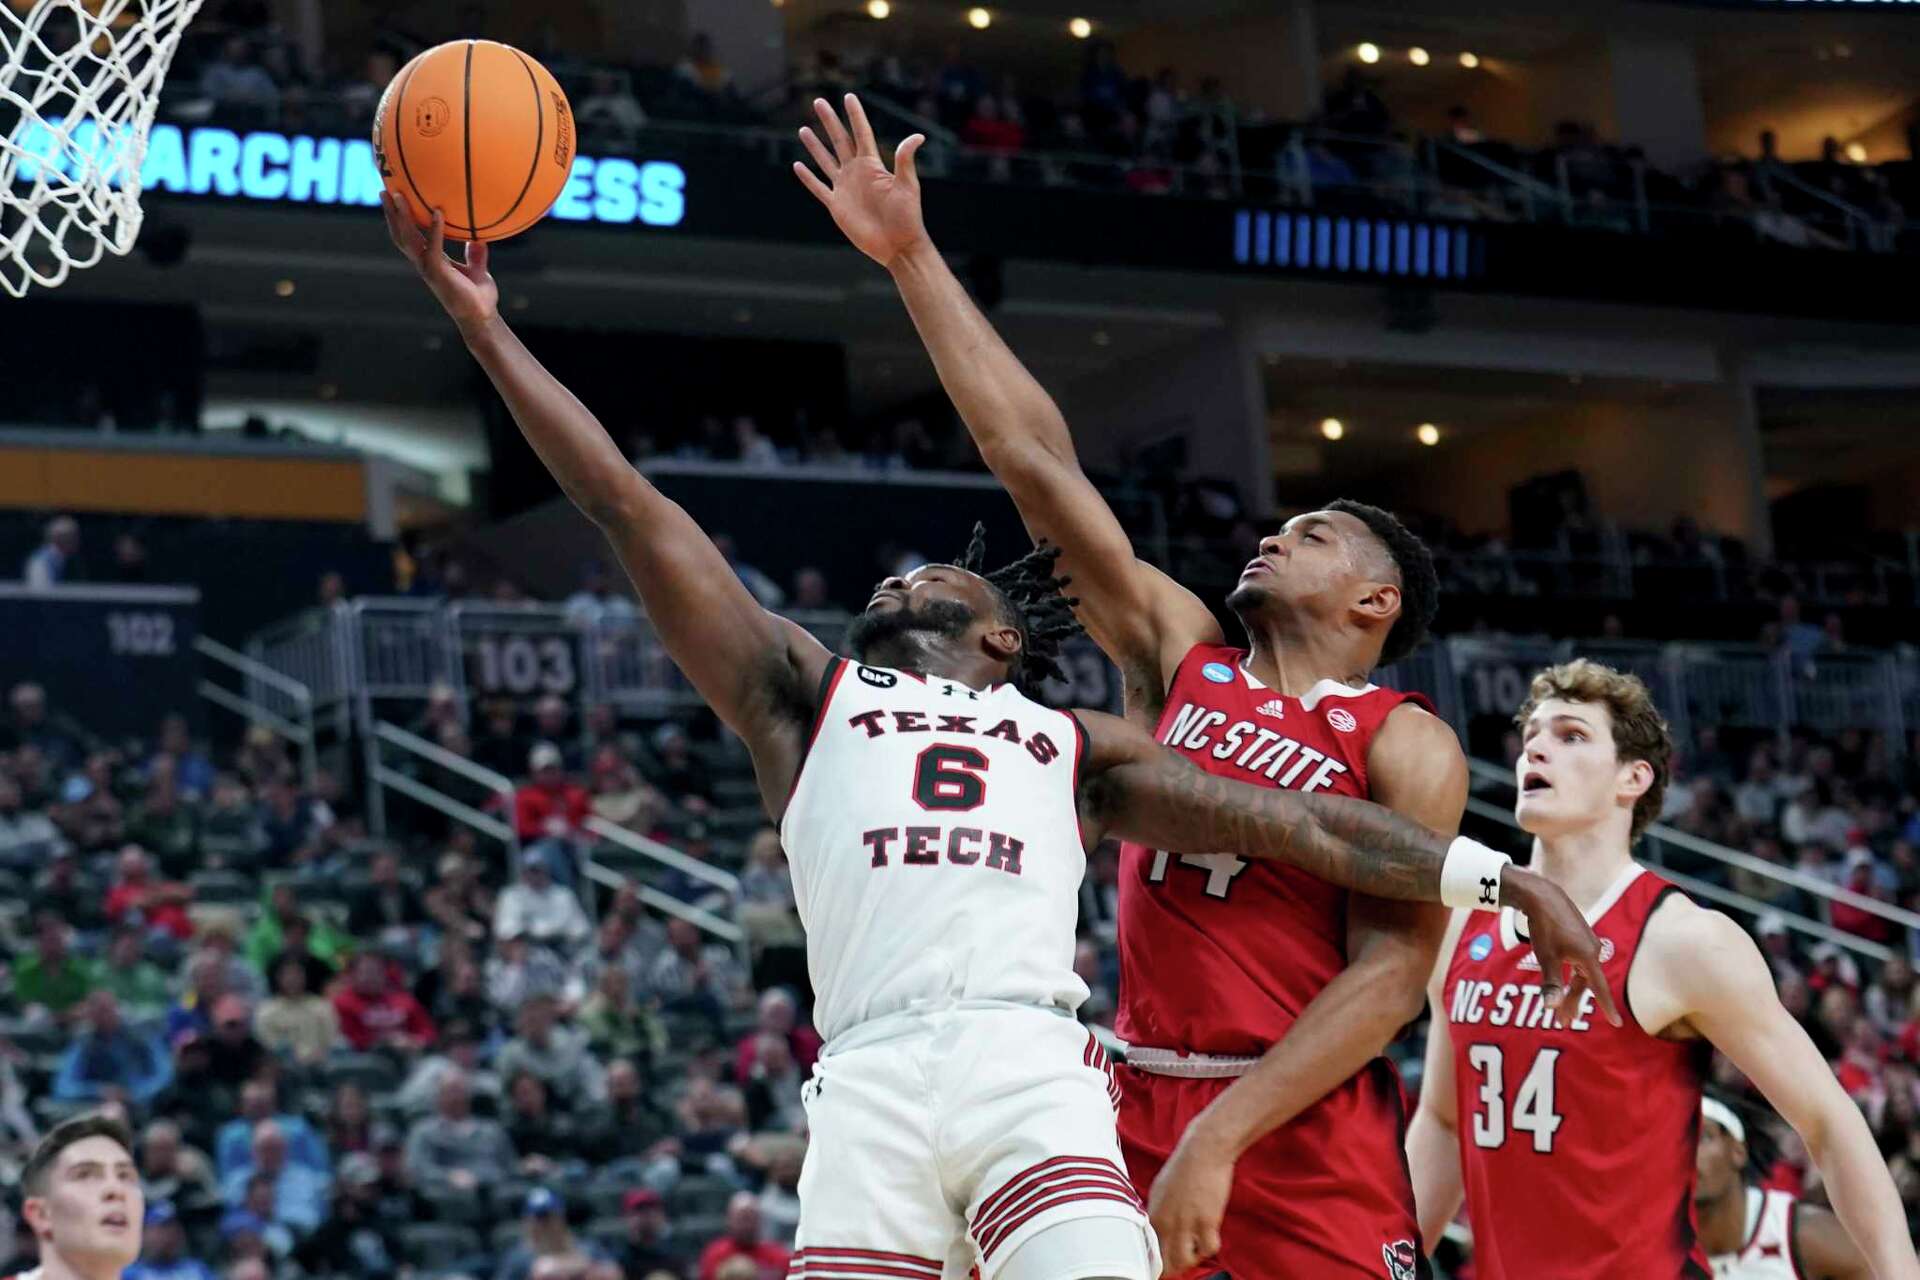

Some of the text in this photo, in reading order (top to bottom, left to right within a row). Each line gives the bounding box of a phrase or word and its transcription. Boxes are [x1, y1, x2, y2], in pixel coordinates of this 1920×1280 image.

[479, 639, 575, 692] 103
[849, 709, 1060, 765] TEXAS
[1163, 703, 1347, 792] NC STATE
[912, 742, 989, 812] 6
[863, 826, 1024, 876] TECH
[1450, 979, 1596, 1031] NC STAE
[1467, 1043, 1563, 1153] 34
